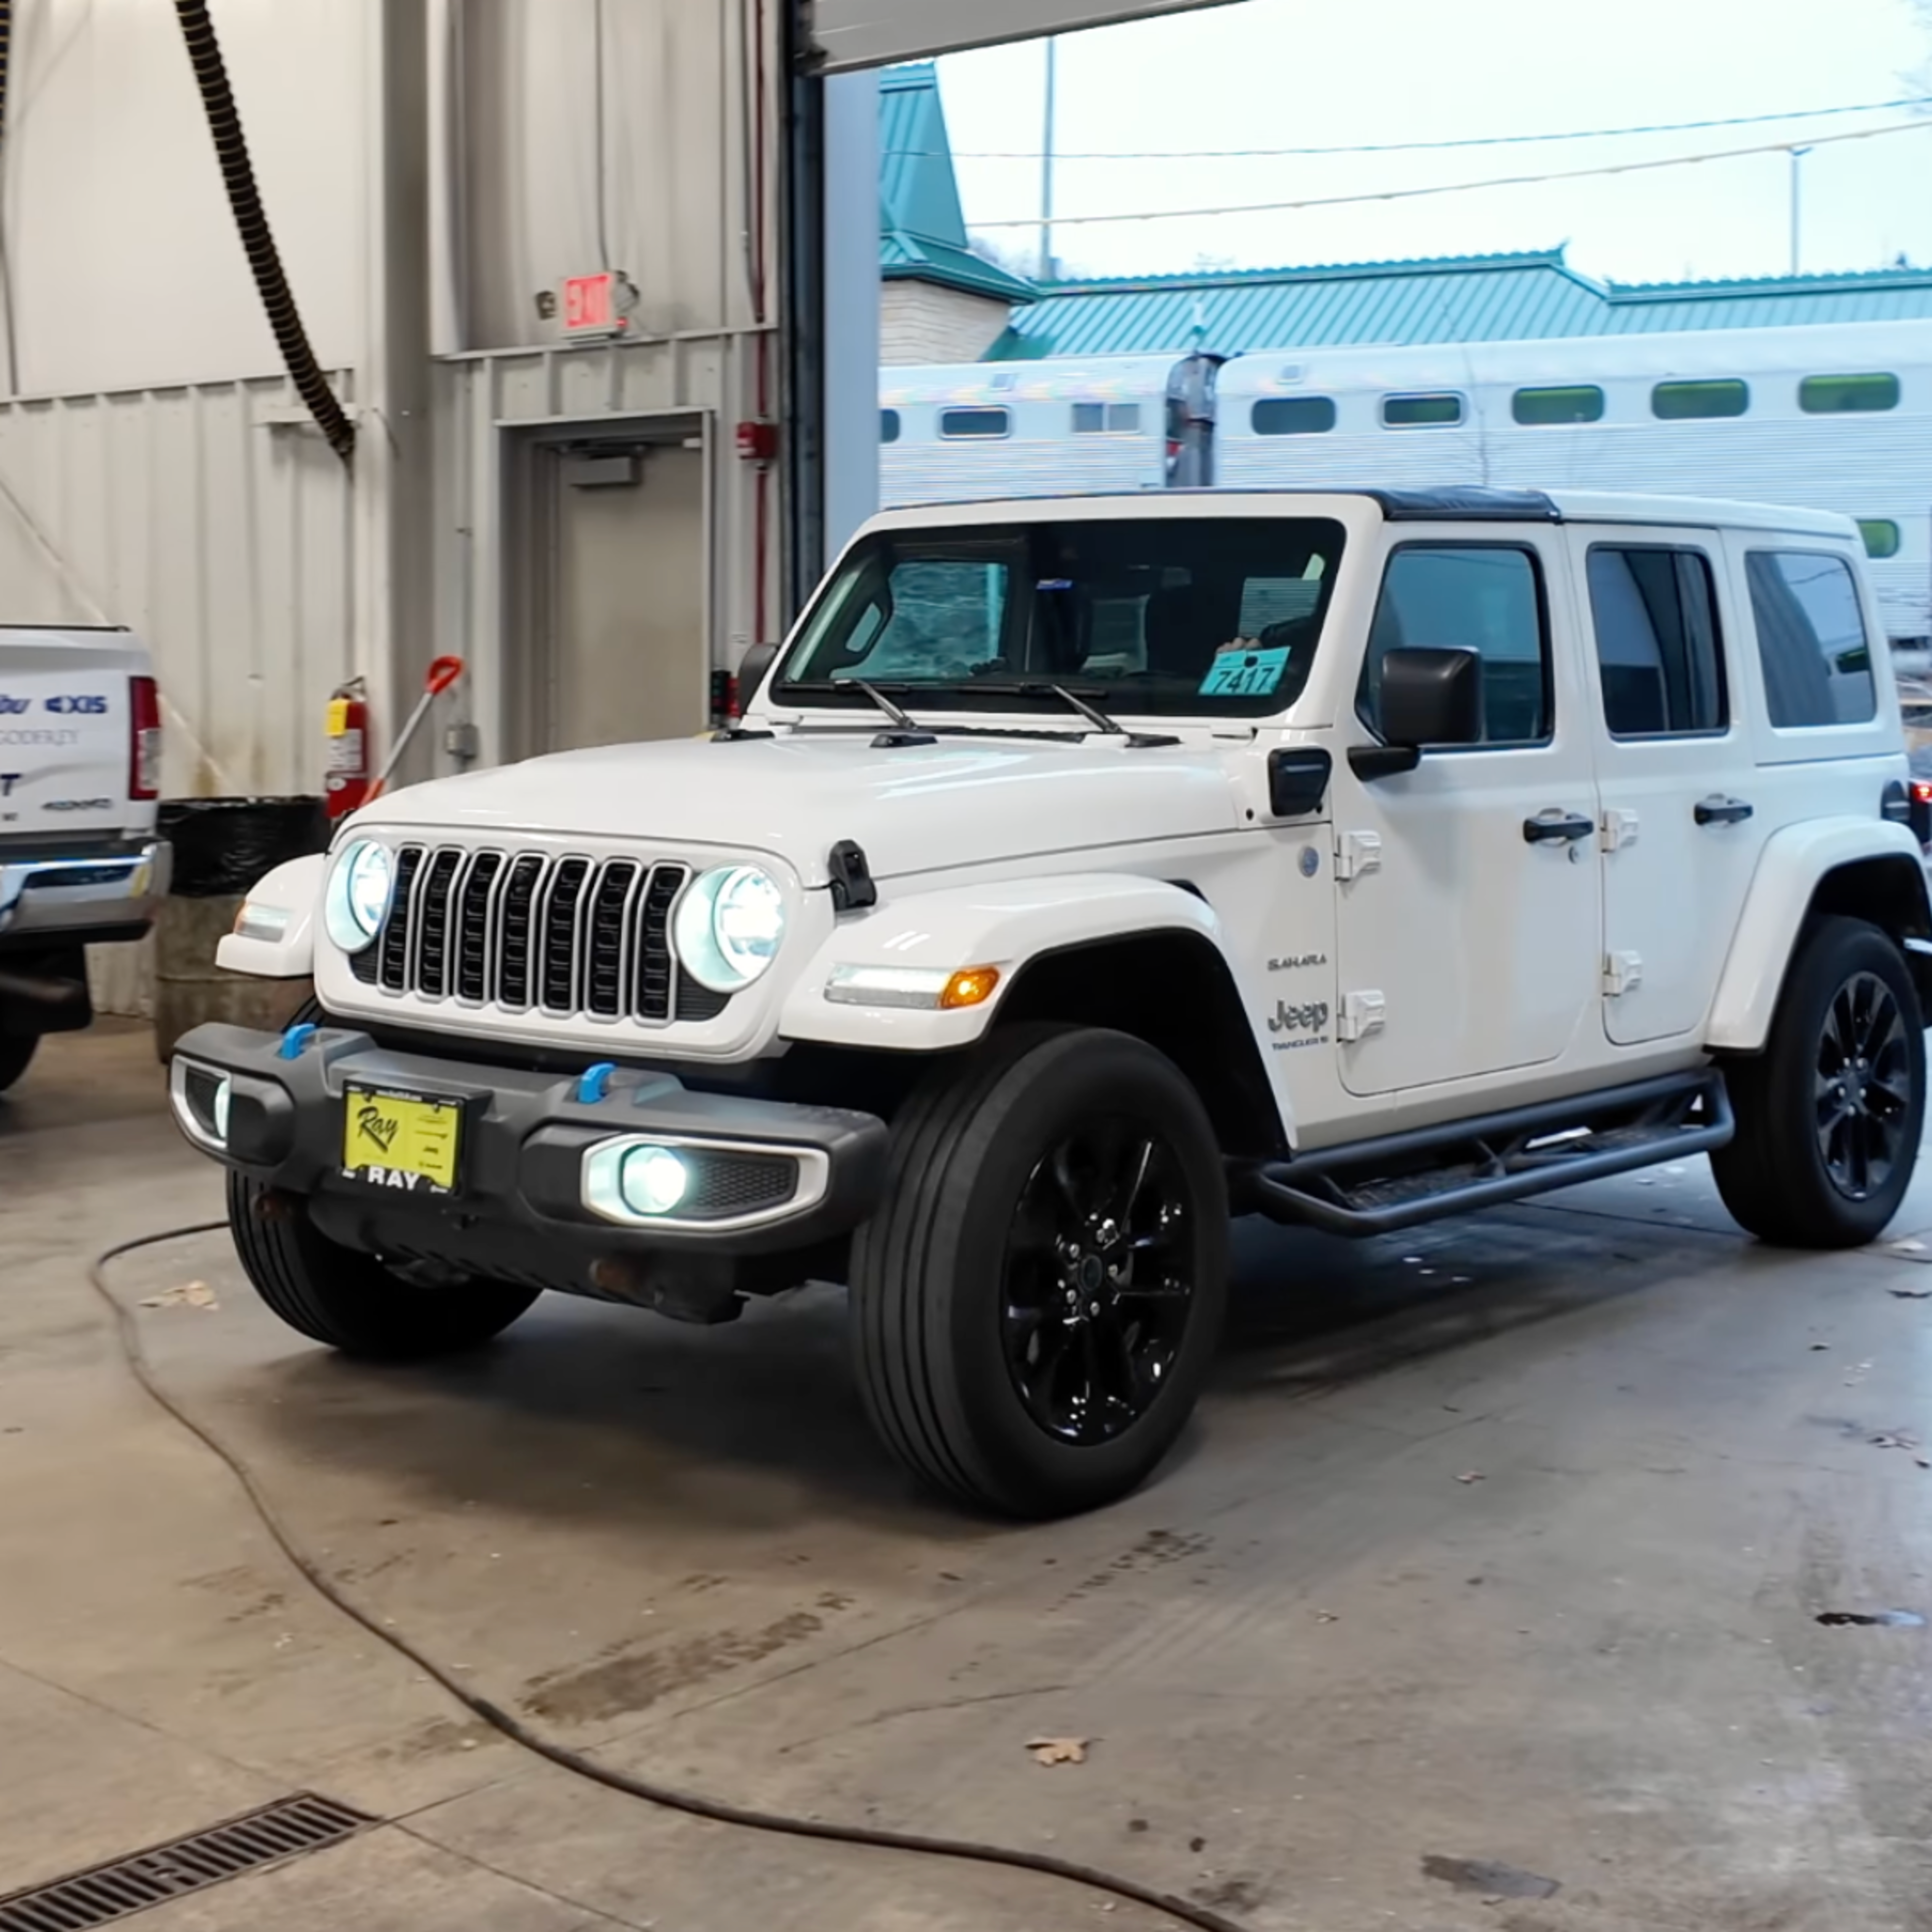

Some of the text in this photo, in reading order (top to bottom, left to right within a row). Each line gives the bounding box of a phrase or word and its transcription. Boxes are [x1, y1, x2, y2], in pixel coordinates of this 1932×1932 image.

[566, 275, 609, 328] EXIT
[1212, 667, 1275, 694] 7417
[1267, 953, 1327, 972] SAHARA
[1267, 999, 1328, 1033] Jeep
[357, 1106, 399, 1154] Ray
[368, 1165, 421, 1191] RAY
